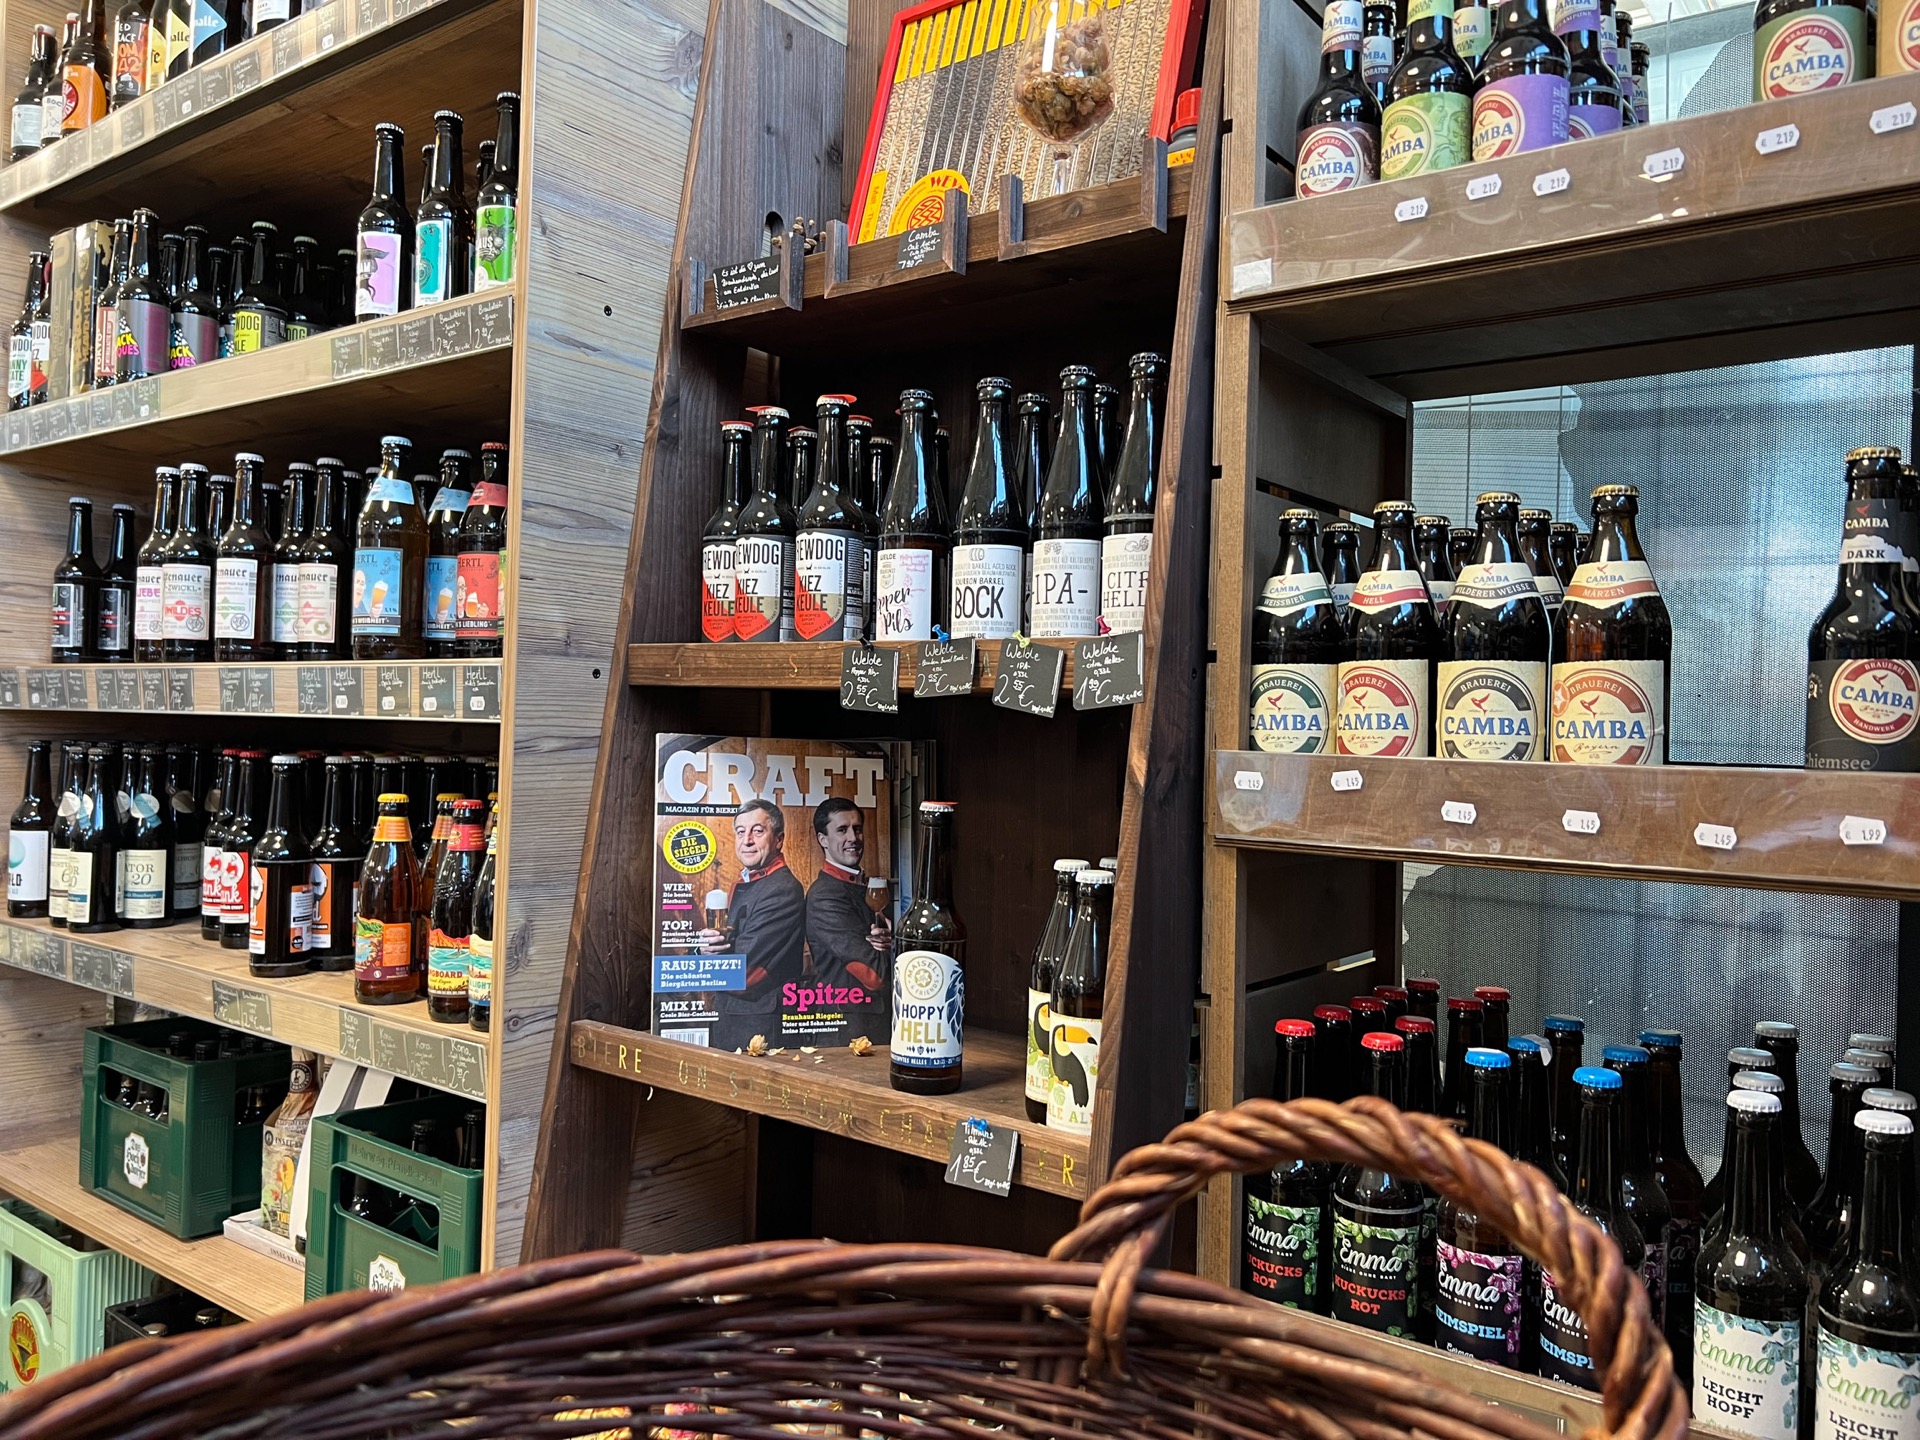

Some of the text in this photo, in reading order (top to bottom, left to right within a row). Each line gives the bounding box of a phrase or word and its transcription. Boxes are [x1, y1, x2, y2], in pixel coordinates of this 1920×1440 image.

[170, 29, 190, 43] alle
[1785, 25, 1828, 44] BRAUEREI
[1769, 54, 1845, 81] CAMBA
[1473, 121, 1514, 149] AMBA
[1300, 161, 1355, 181] CAMBA
[908, 226, 940, 243] Camba
[1845, 517, 1890, 530] CAMBA
[1846, 549, 1886, 560] DARK
[799, 575, 822, 593] KIEZ
[979, 576, 1005, 586] BARREL
[1472, 575, 1510, 584] CAMBA
[1586, 574, 1625, 583] CAMBA
[707, 583, 730, 600] KIEZ
[1269, 585, 1301, 594] CAMBA
[1362, 583, 1393, 592] CAMBA
[1455, 582, 1531, 599] WILDERER WEISSE
[703, 600, 735, 617] KEULE
[955, 584, 1004, 619] BOCK
[1362, 596, 1385, 605] HELL
[882, 611, 914, 636] Pils
[1040, 630, 1061, 638] WELDE
[851, 650, 883, 667] Welde
[925, 643, 956, 658] Welde
[1005, 642, 1041, 662] Welde
[1083, 640, 1120, 660] Welde
[1864, 662, 1906, 676] BRAUEREI
[1260, 678, 1303, 693] BRAUEREI
[1346, 676, 1387, 691] BRAUEREI
[1459, 678, 1511, 694] BRAUEREI
[1569, 679, 1623, 695] BRAUEREI
[1841, 685, 1915, 711] CAMBA
[1444, 716, 1532, 736] CAMBA
[1555, 719, 1647, 740] CAMBA
[1853, 718, 1896, 733] HANDWERK
[1807, 752, 1871, 770] hiemsee
[663, 749, 885, 808] CRAFT
[665, 805, 699, 814] MAGAZIN
[700, 804, 715, 814] FÜR
[665, 821, 709, 842] INTERNATIONAL
[680, 837, 698, 847] DIE
[673, 844, 707, 858] SIEGER
[668, 858, 686, 872] CRAFT
[684, 855, 702, 866] 2018
[131, 873, 153, 886] 20
[663, 883, 693, 892] WIEN
[661, 920, 693, 931] TOP!
[661, 959, 742, 973] RAUS JETZT!
[907, 959, 939, 979] MAISEL
[661, 971, 711, 980] Die schönsten
[661, 979, 727, 989] Biergärten Berlins
[915, 978, 940, 995] FRIENDS
[782, 982, 872, 1012] Spitze.
[660, 1000, 705, 1012] MIX IT
[677, 1010, 719, 1018] Bier-Cocktails
[902, 1003, 946, 1020] HOPPY
[782, 1012, 844, 1021] Brauhaus Riegele:
[825, 1019, 848, 1028] machen
[782, 1026, 839, 1036] keine Kompromisse
[900, 1018, 948, 1044] HELL
[1339, 1234, 1403, 1273] Emma
[1252, 1270, 1278, 1290] ROT
[1334, 1273, 1406, 1301] KUCKUCKS
[1438, 1258, 1500, 1304] Emma
[1350, 1298, 1381, 1316] ROT
[1699, 1323, 1776, 1376] Emma
[1701, 1375, 1764, 1406] LEICHT
[1826, 1356, 1912, 1411] Emma
[1706, 1394, 1755, 1420] HOPF
[1829, 1410, 1899, 1440] LEICHT
